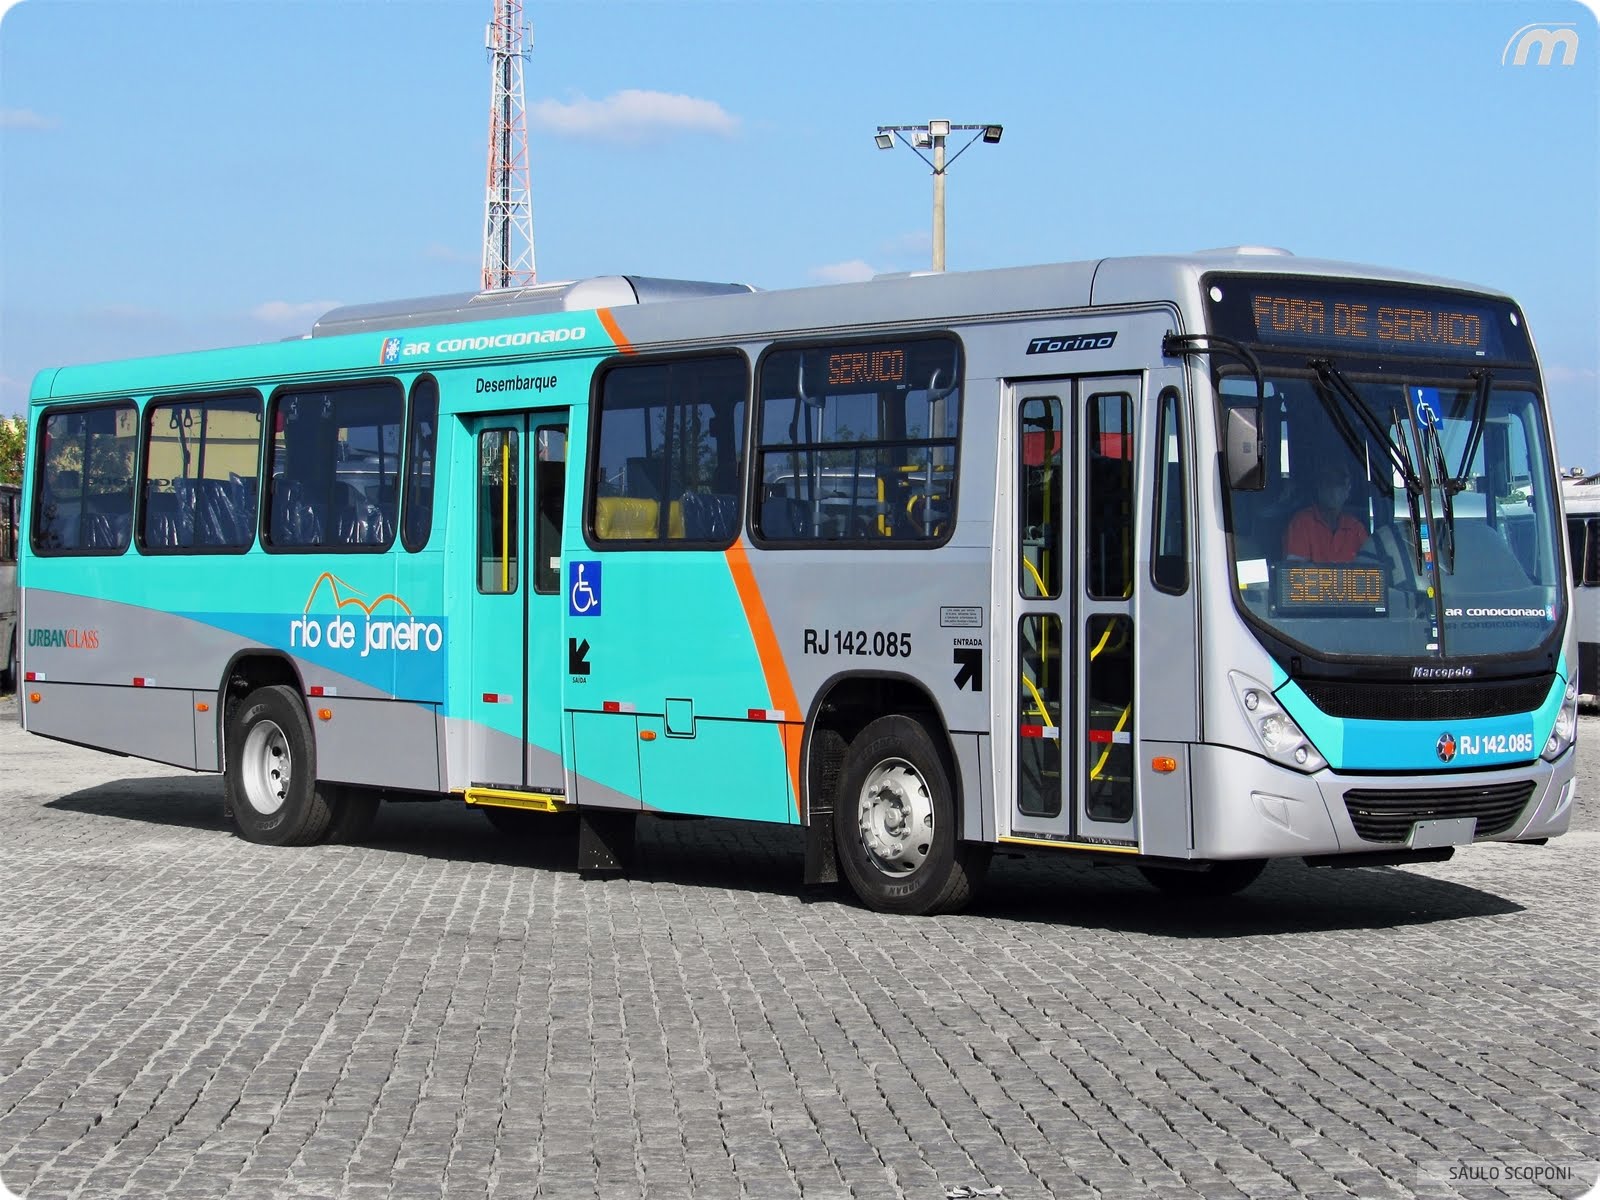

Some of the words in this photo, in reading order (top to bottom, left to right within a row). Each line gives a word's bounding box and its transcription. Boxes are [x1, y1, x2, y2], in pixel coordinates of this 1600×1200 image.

[1254, 295, 1324, 334] FORA
[1334, 303, 1368, 337] DE
[1377, 306, 1480, 346] SERVICO
[436, 326, 586, 353] CONDICIONADO
[1032, 336, 1113, 352] Torino
[828, 350, 904, 385] SERVICO
[475, 375, 558, 394] Desembarque
[1289, 568, 1380, 602] SERVICO
[290, 614, 322, 648] rio
[326, 615, 356, 649] de
[360, 614, 443, 657] janeiro
[804, 629, 829, 655] RJ
[833, 630, 912, 658] 142.085
[953, 638, 983, 646] ENTRADA
[1412, 666, 1473, 679] Marcopolo
[1460, 735, 1480, 755] RJ
[1482, 734, 1533, 754] 142.085
